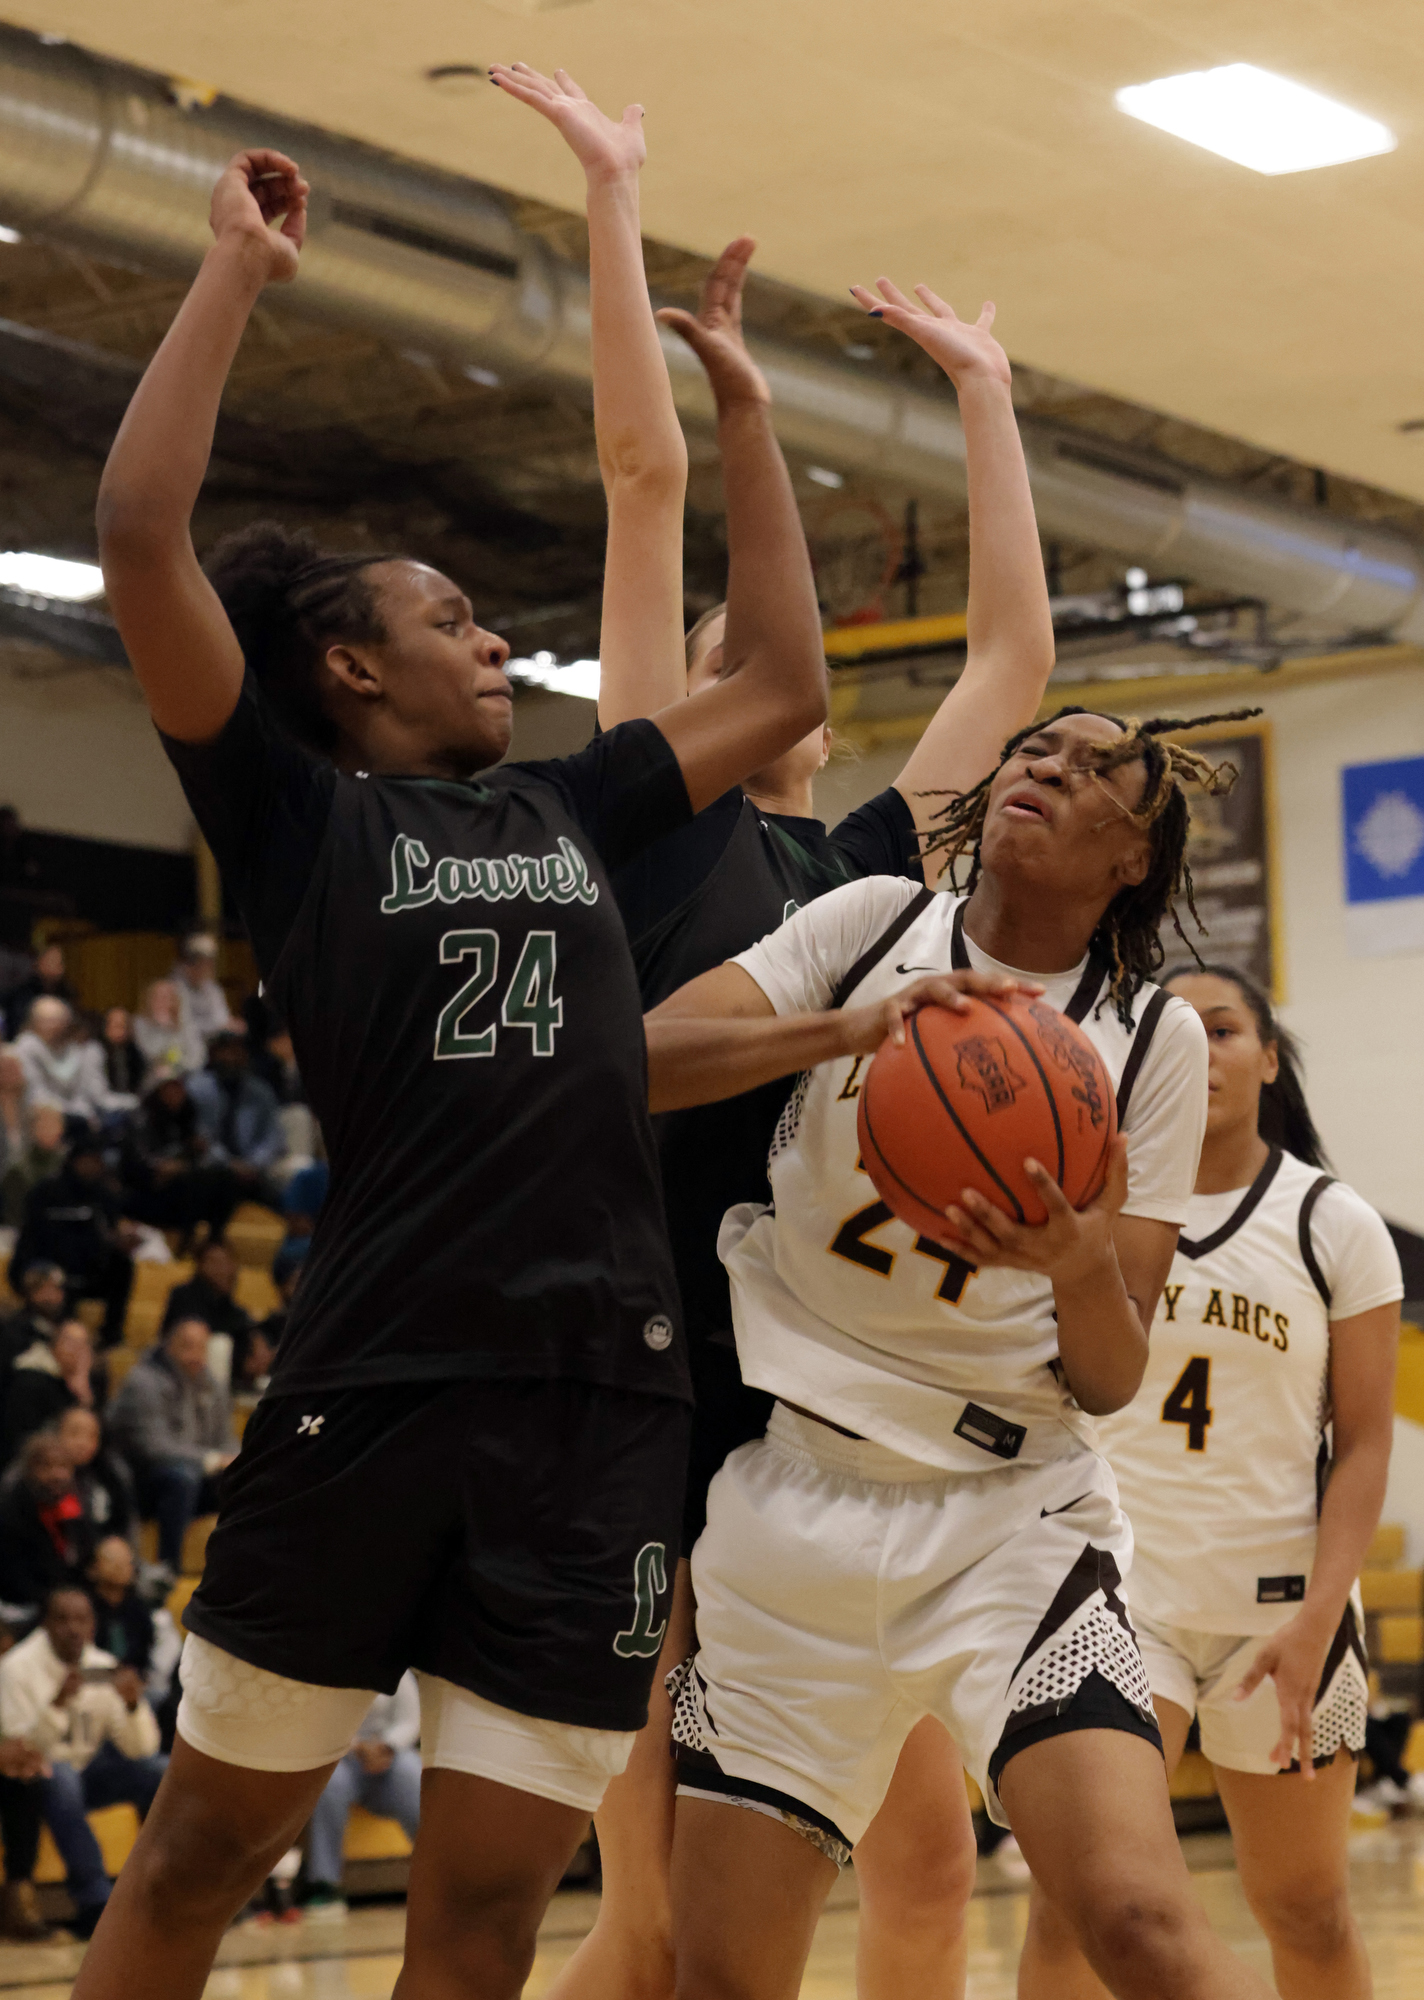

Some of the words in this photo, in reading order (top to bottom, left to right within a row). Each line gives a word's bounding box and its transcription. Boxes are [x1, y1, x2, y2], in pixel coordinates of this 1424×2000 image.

[381, 833, 598, 914] Laurel
[433, 928, 563, 1060] 24
[1202, 1288, 1290, 1352] ARCS
[1160, 1355, 1213, 1453] 4
[613, 1541, 667, 1658] L
